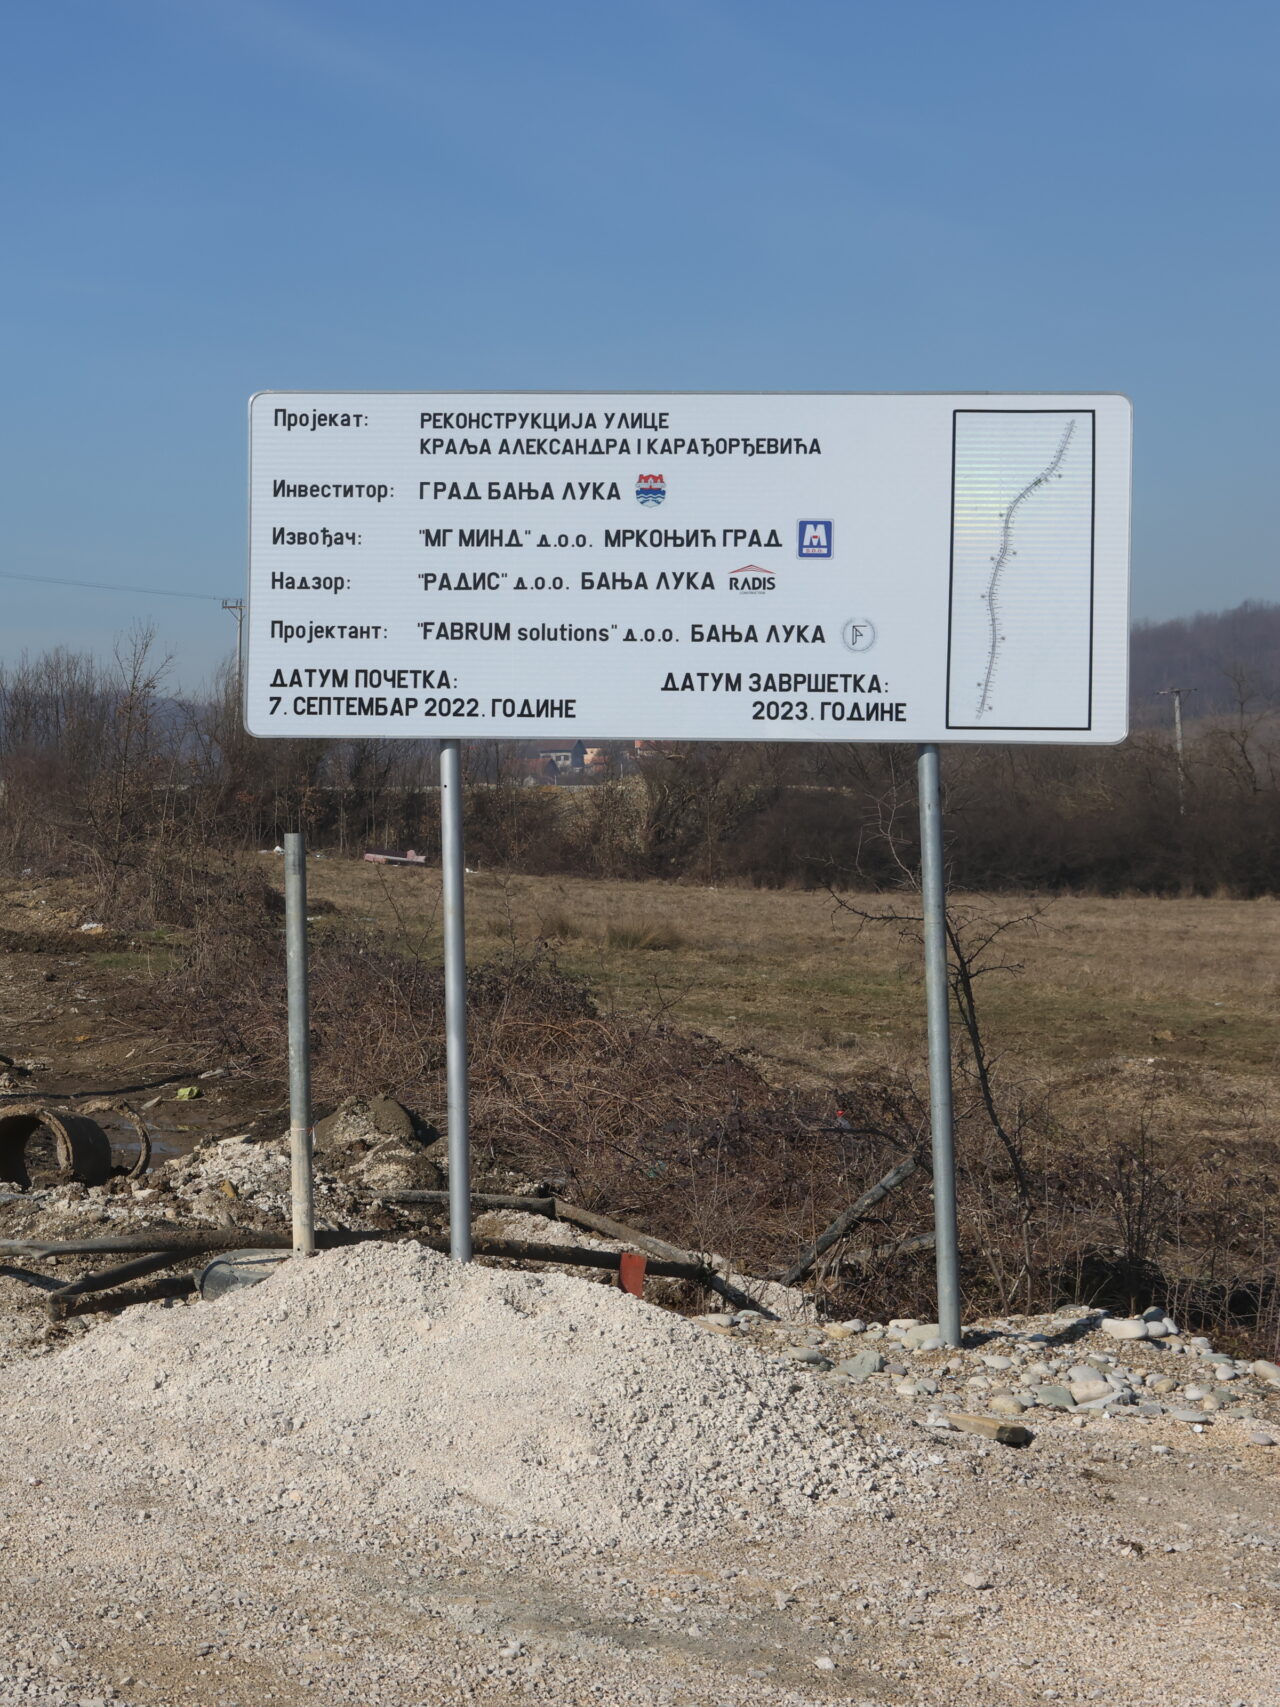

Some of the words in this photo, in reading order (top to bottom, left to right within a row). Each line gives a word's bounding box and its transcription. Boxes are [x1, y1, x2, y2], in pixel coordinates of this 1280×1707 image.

[273, 408, 369, 432] Пројекат:
[420, 412, 598, 433] РЕКОНСТРУКЦИЈА
[603, 412, 670, 432] УЛИЦЕ
[419, 437, 492, 456] КРАЉА
[497, 438, 632, 456] АЛЕКСАНДРА
[646, 437, 822, 458] КАРАЂОРЂЕВИЋА
[272, 479, 394, 503] Инвеститор:
[419, 481, 483, 501] ГРАД
[487, 481, 555, 501] БАЊА
[561, 481, 622, 501] ЛУКА
[272, 526, 362, 548] Извођач:
[458, 528, 531, 548] МИНД"
[536, 533, 593, 548] д.о.о.
[604, 528, 717, 548] МРКОЊИЋ
[722, 528, 783, 548] ГРАД
[271, 571, 351, 595] Надзор:
[417, 571, 508, 592] "РАДИС"
[512, 576, 570, 591] д.о.о.
[581, 571, 649, 591] БАЊА
[655, 571, 716, 591] ЛУКА
[729, 576, 777, 591] RADIS
[270, 619, 388, 644] Пројектант:
[417, 621, 511, 642] "FABRUM
[517, 622, 618, 642] solutions"
[690, 623, 759, 643] БАЊА
[765, 624, 826, 644] ЛУКА
[269, 668, 349, 689] ДАТУМ
[354, 668, 458, 690] ПОЧЕТКА:
[660, 672, 742, 693] ДАТУМ
[748, 672, 889, 694] ЗАВРШЕТКА:
[268, 696, 288, 716] 7.
[293, 695, 419, 718] СЕПТЕМБАР
[424, 697, 486, 719] 2022.
[491, 698, 577, 719] ГОДИНЕ
[751, 700, 815, 721] 2023.
[820, 701, 907, 723] ГОДИНЕ
